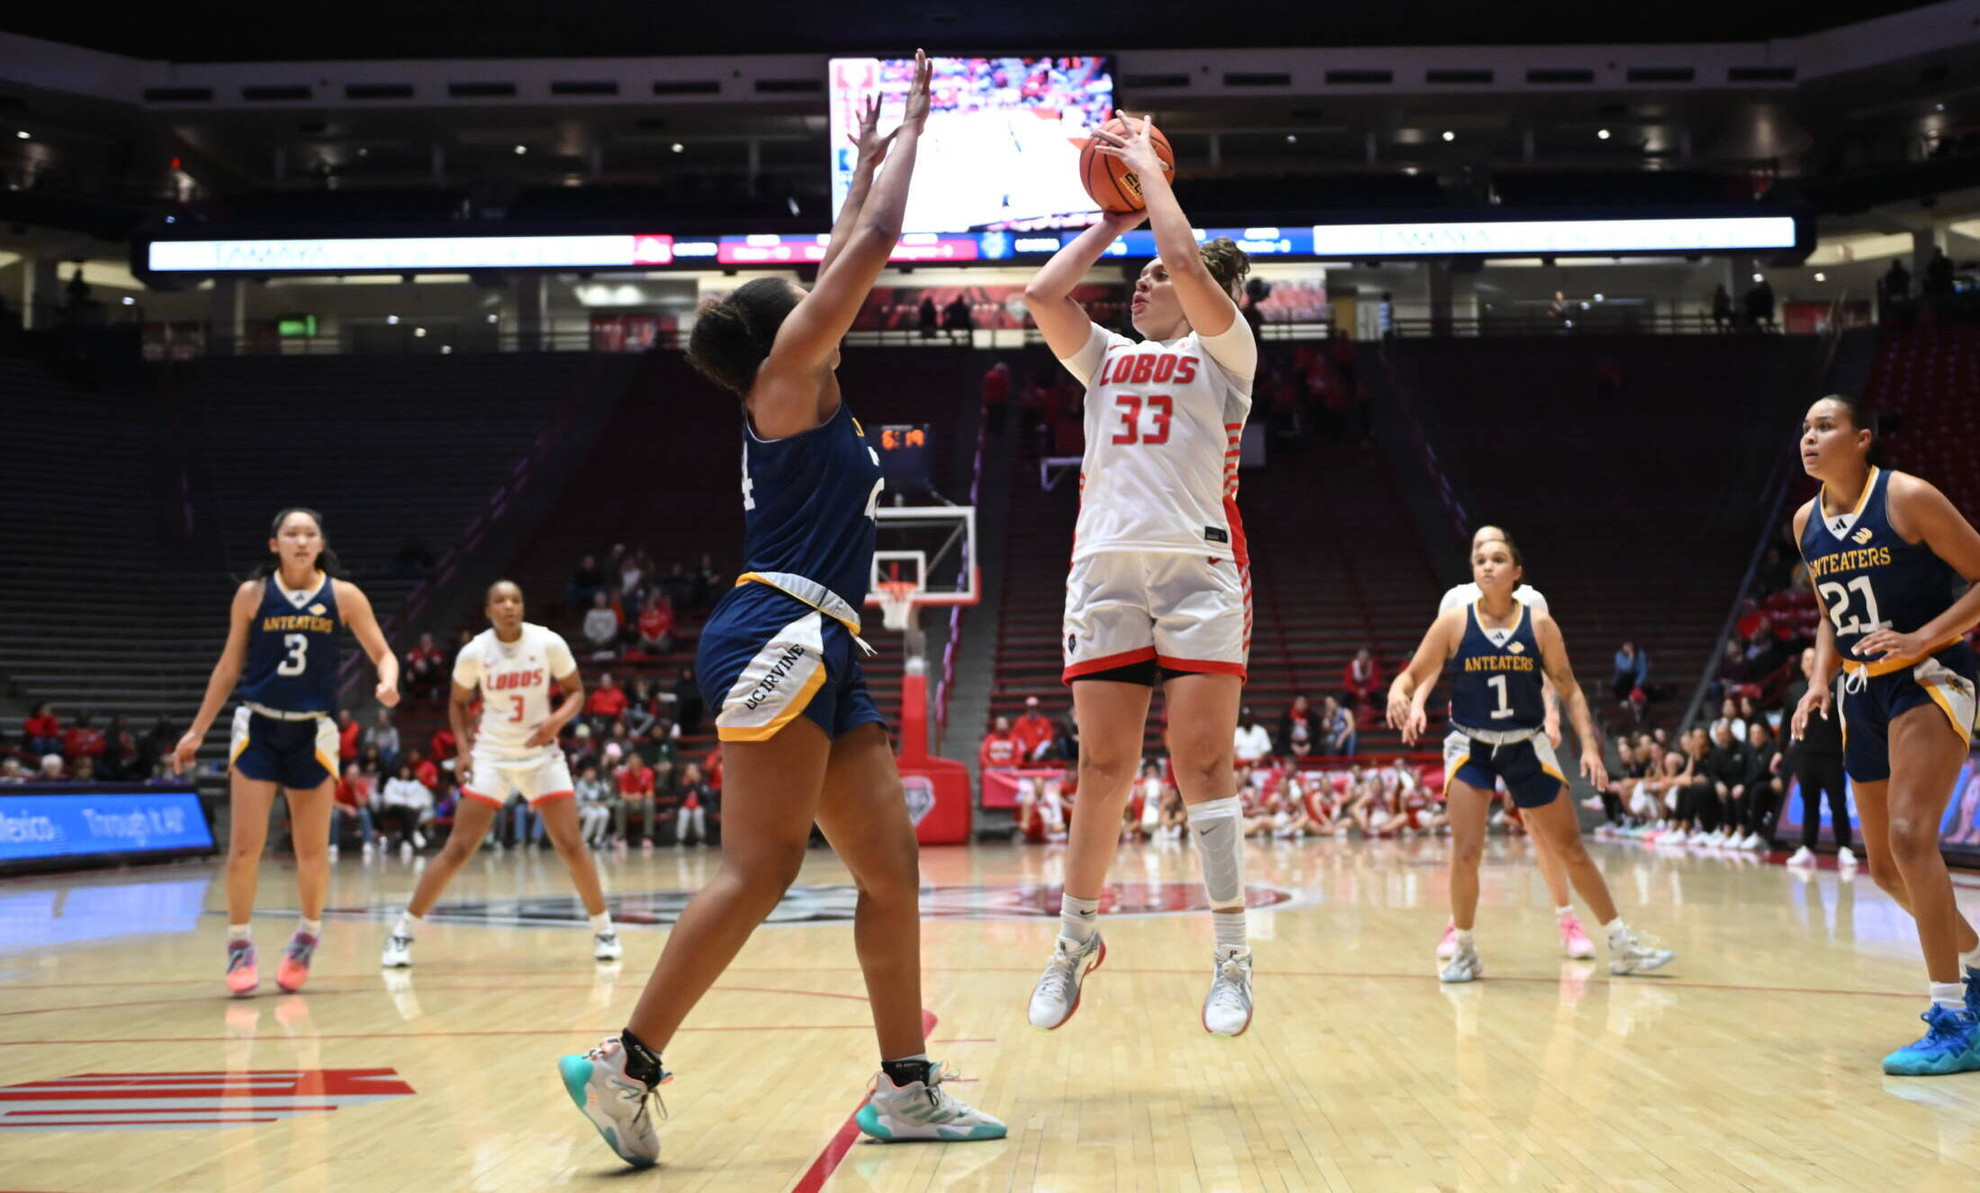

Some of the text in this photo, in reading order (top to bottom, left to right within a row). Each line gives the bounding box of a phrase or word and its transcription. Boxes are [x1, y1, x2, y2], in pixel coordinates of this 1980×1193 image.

[1099, 354, 1199, 387] LOBOS
[1112, 395, 1173, 445] 33
[263, 615, 333, 634] ANTEATERS
[1818, 575, 1893, 637] 21
[277, 633, 308, 676] 3
[1464, 655, 1534, 672] ANTEATERS
[486, 668, 544, 691] LOBOS
[744, 643, 805, 711] UC IRVINE
[508, 694, 524, 723] 3
[1487, 674, 1514, 719] 1
